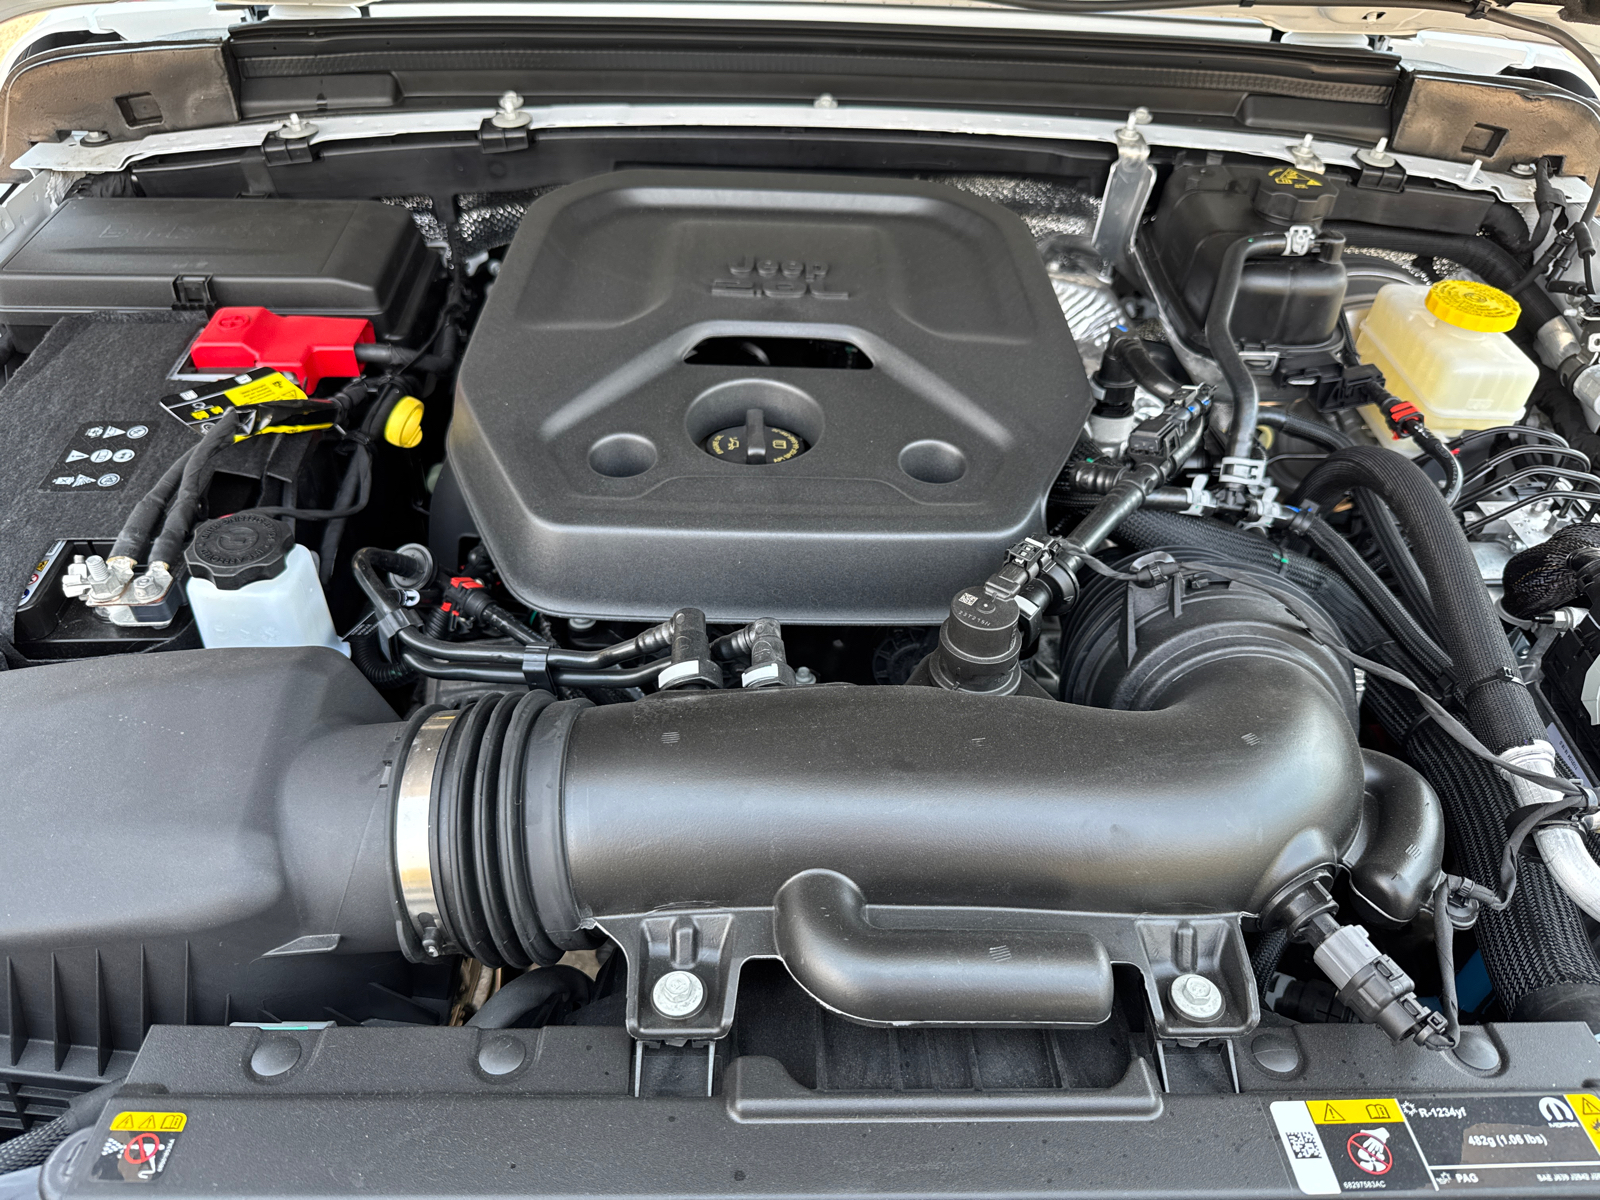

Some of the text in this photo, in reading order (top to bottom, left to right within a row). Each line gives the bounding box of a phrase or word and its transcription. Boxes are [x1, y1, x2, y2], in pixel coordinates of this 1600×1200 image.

[728, 253, 829, 282] Jeep
[1418, 1106, 1467, 1119] R-1234yf
[1468, 1133, 1548, 1148] 482g (1.06 lbs)
[1455, 1172, 1479, 1183] PAG
